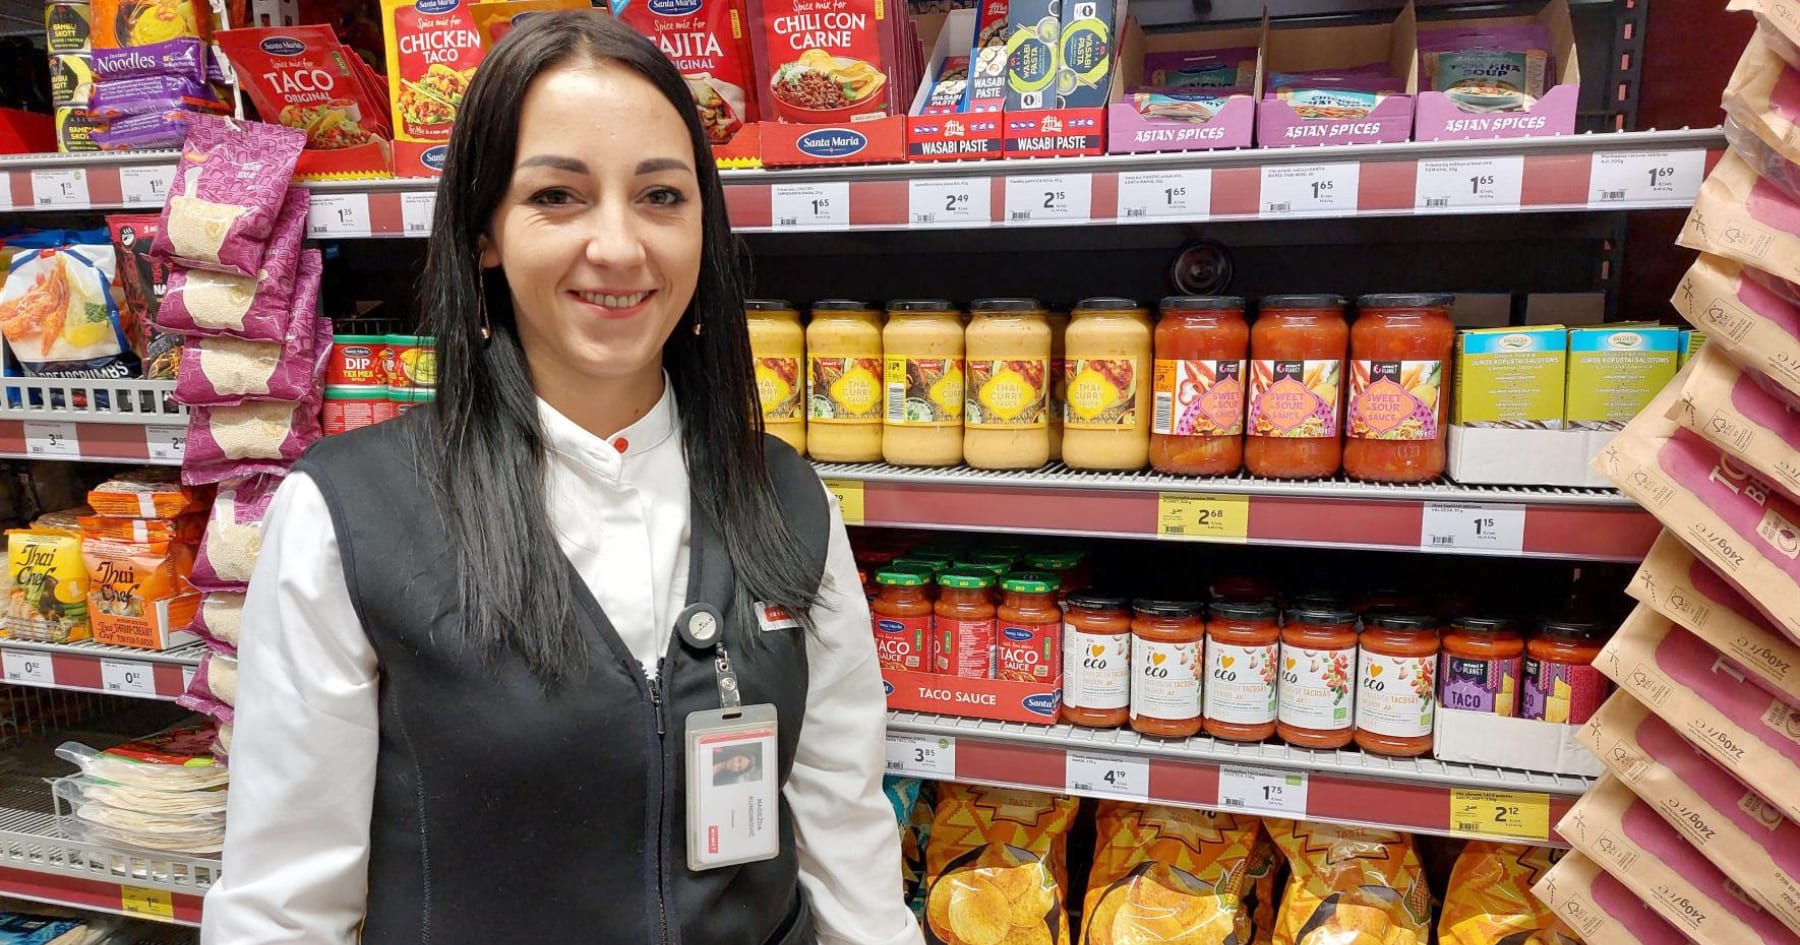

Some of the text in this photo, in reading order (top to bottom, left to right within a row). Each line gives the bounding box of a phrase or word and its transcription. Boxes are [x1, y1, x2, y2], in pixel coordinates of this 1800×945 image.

[653, 0, 674, 9] Santa
[793, 0, 848, 12] Spice mix for
[417, 18, 462, 29] Spice mix for
[654, 19, 706, 32] Spice mix for
[774, 13, 867, 33] CHILI CON
[400, 31, 482, 53] CHICKEN
[789, 31, 852, 50] CARNE
[422, 49, 459, 63] TACO
[1077, 37, 1085, 66] PASTA
[97, 54, 156, 73] Noodles
[1031, 47, 1039, 74] PASTA
[263, 69, 335, 95] TACO
[974, 77, 1005, 88] WASABI
[284, 92, 332, 103] ORIGINAL
[931, 94, 962, 102] WASABI
[976, 87, 1002, 98] PASTE
[931, 98, 958, 106] PASTE
[1286, 123, 1382, 138] ASIAN SPICES
[1444, 117, 1546, 132] ASIAN SPICES
[803, 135, 859, 147] Santa Maria
[1135, 127, 1225, 142] ASIAN SPICES
[922, 139, 988, 155] WASABI PASTE
[1018, 136, 1087, 151] WASABI PASTE
[345, 358, 371, 370] DIP
[996, 383, 1020, 392] THAI
[1078, 383, 1101, 392] THAI
[989, 391, 1024, 400] CURRY
[1074, 391, 1106, 400] CURRY
[1270, 392, 1304, 401] SWEET
[1366, 393, 1401, 402] SWEET
[1276, 401, 1304, 410] SOUR
[1371, 402, 1400, 412] SOUR
[1367, 413, 1397, 422] SAUCE
[16, 544, 57, 567] Thai
[95, 561, 134, 584] Thai
[16, 567, 57, 592] Chef
[100, 583, 141, 610] Chef
[1000, 647, 1039, 664] TACO
[1004, 661, 1030, 672] SAUCE
[1083, 658, 1107, 670] eco
[1144, 666, 1168, 679] eco
[1214, 669, 1237, 682] eco
[1281, 669, 1298, 684] eco
[1462, 667, 1484, 676] PLANET
[1363, 676, 1385, 691] eco
[919, 687, 997, 706] TACO SAUCE
[1027, 698, 1052, 708] Santa
[1451, 691, 1481, 708] TACO
